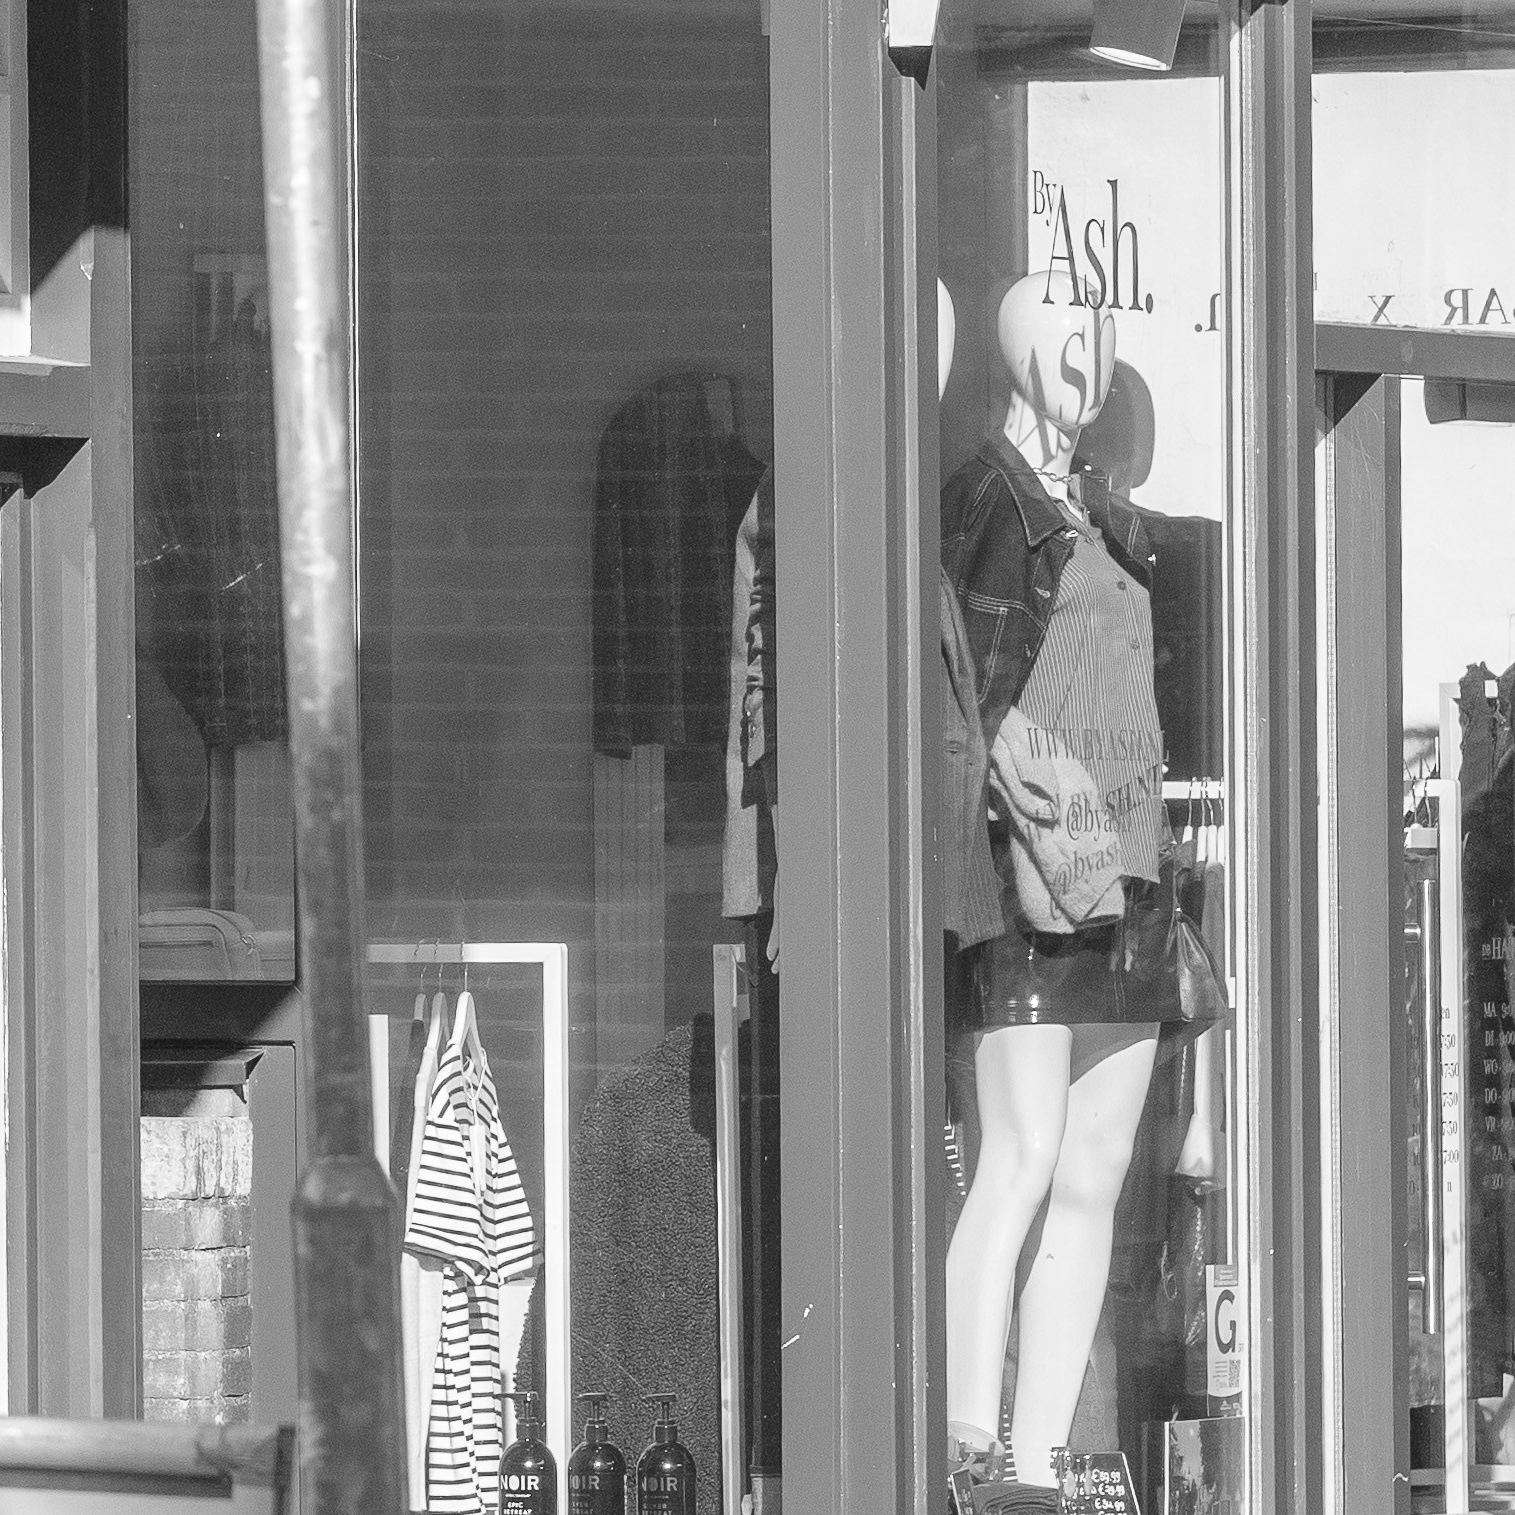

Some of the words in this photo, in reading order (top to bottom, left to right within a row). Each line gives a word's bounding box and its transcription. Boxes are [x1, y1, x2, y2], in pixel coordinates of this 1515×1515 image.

[1032, 170, 1057, 226] By
[1042, 178, 1154, 314] Ash.
[1215, 1289, 1236, 1354] G
[500, 1474, 540, 1491] NOIR
